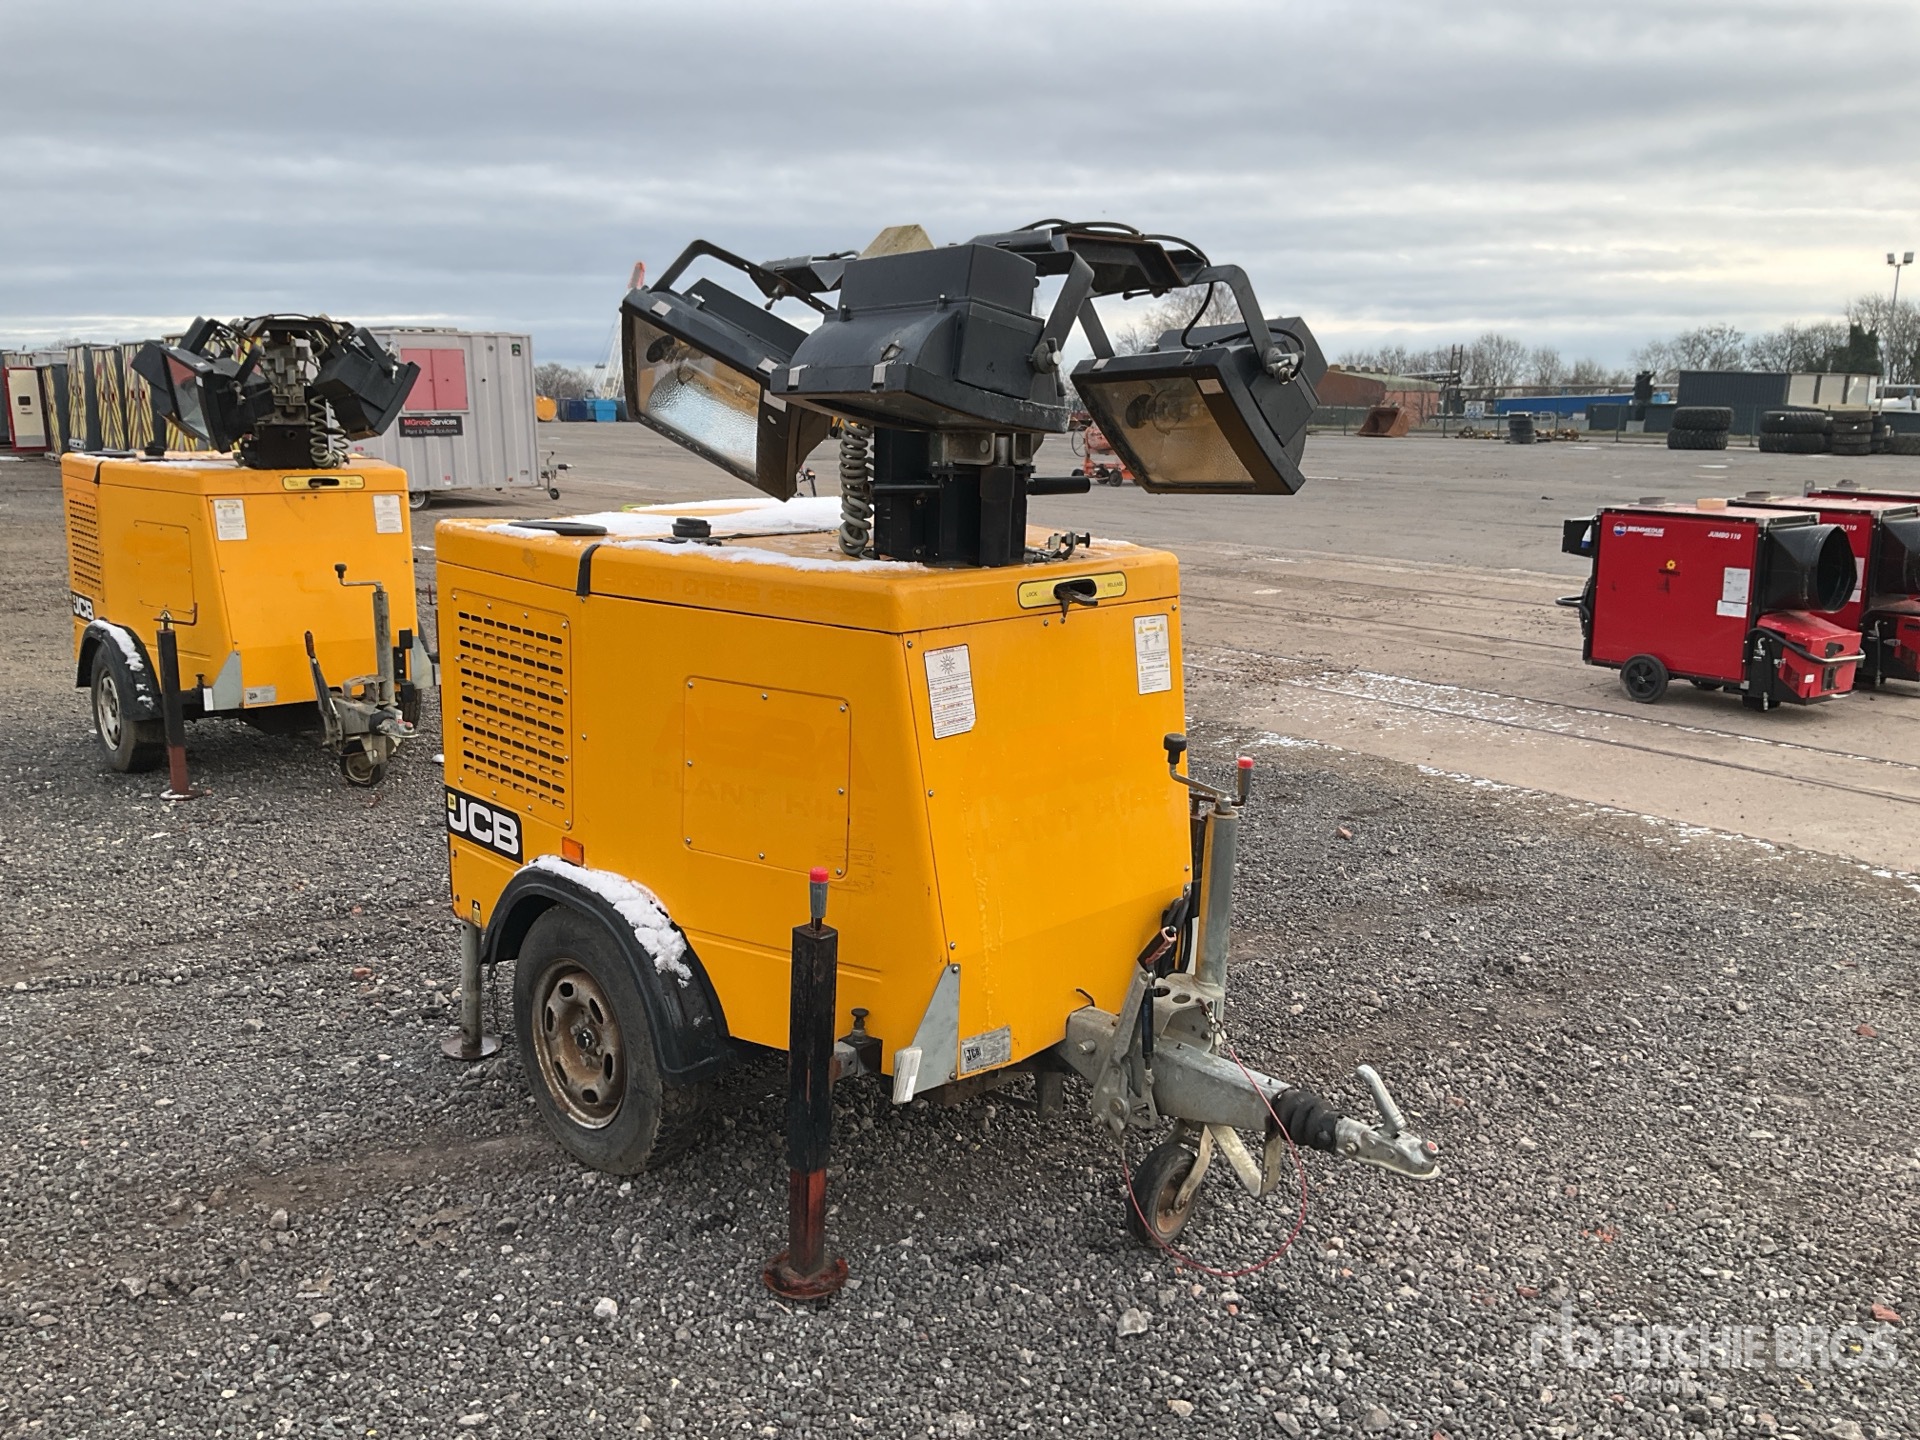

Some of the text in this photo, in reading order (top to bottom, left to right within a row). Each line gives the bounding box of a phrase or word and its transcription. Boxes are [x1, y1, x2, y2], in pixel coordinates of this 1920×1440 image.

[1708, 531, 1729, 539] JUMBO
[73, 595, 95, 620] JCB
[448, 797, 518, 855] JCB
